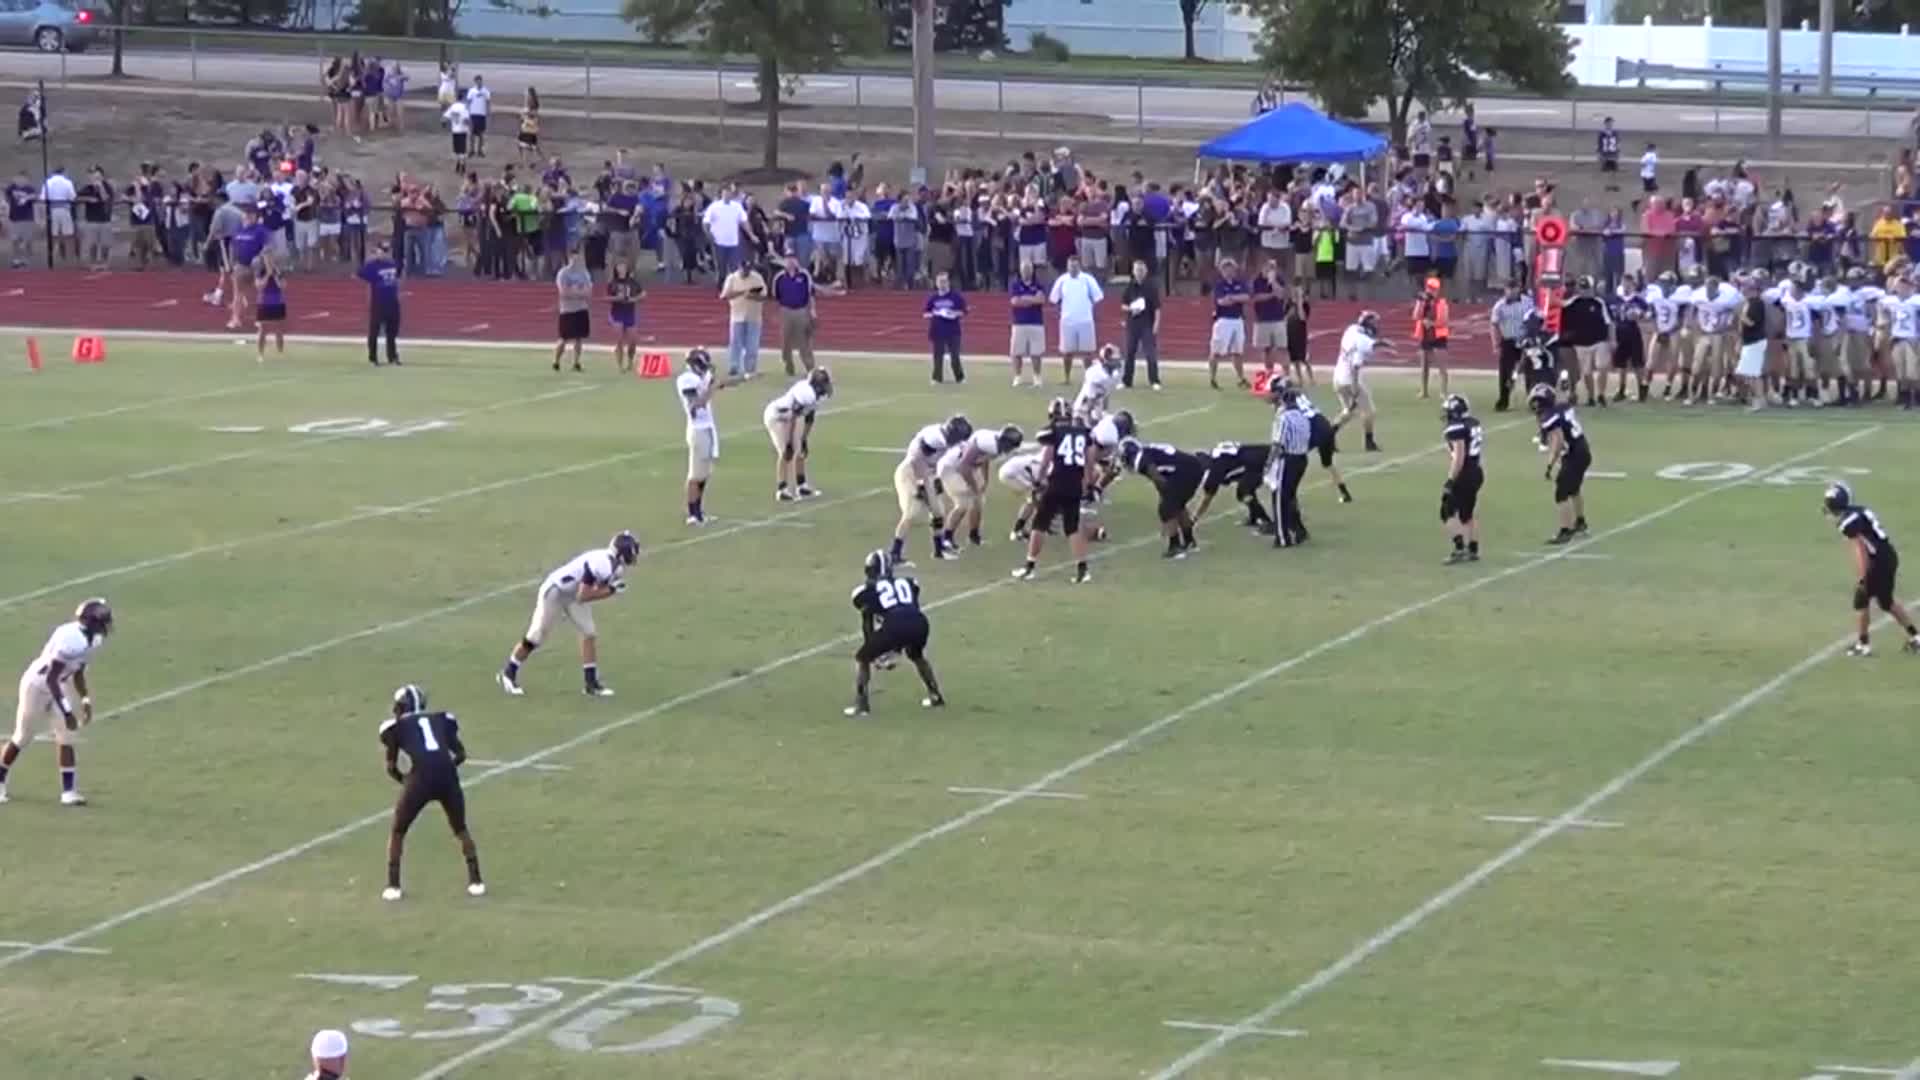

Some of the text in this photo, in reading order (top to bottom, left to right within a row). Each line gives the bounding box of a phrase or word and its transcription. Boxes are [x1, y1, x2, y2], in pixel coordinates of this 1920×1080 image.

[78, 338, 93, 358] G
[642, 354, 661, 375] 10
[1057, 433, 1087, 466] 49
[876, 578, 913, 609] 20
[418, 717, 439, 751] 1
[350, 982, 740, 1053] 30
